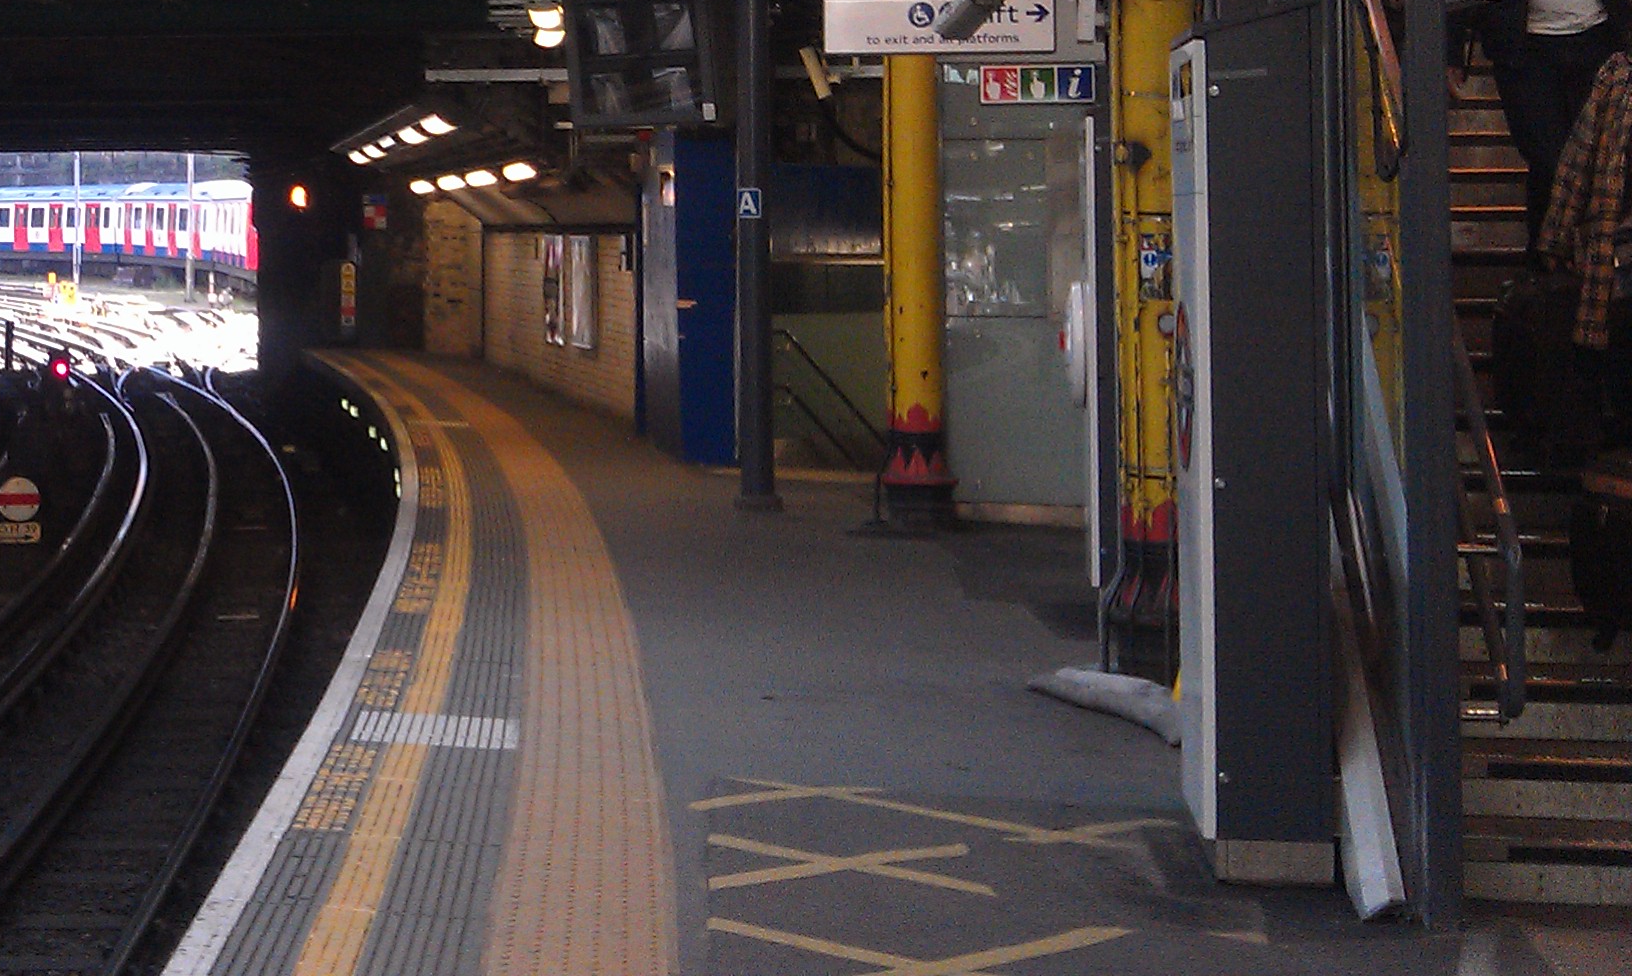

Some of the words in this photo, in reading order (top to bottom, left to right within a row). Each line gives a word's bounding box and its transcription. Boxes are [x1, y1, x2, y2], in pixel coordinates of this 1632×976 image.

[866, 36, 881, 46] to
[885, 34, 909, 46] exit
[912, 33, 934, 46] and
[740, 191, 758, 214] A
